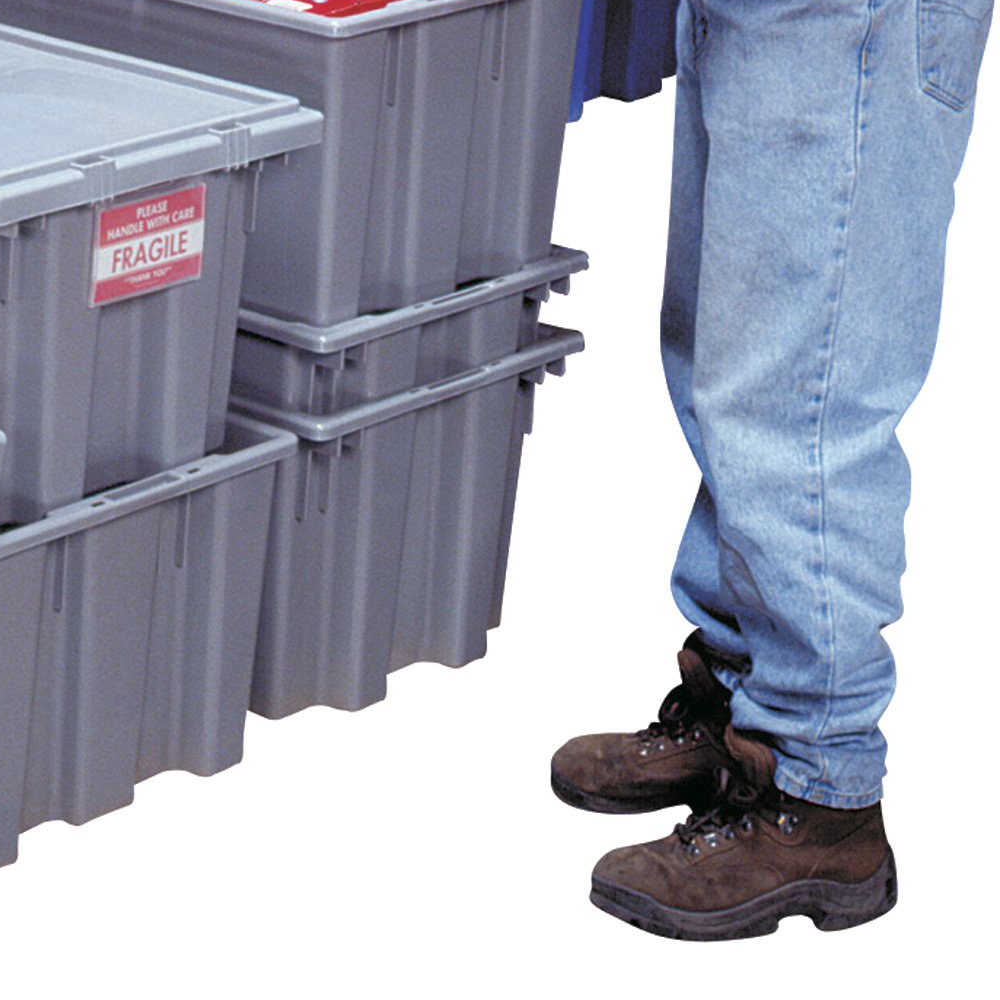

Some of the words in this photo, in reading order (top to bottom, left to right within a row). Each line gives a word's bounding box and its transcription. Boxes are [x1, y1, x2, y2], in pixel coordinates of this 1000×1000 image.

[106, 221, 144, 241] HANDLE
[146, 215, 169, 230] WITH
[172, 206, 195, 223] CARE
[136, 200, 168, 219] PLEASE
[111, 230, 188, 273] FRAGILE
